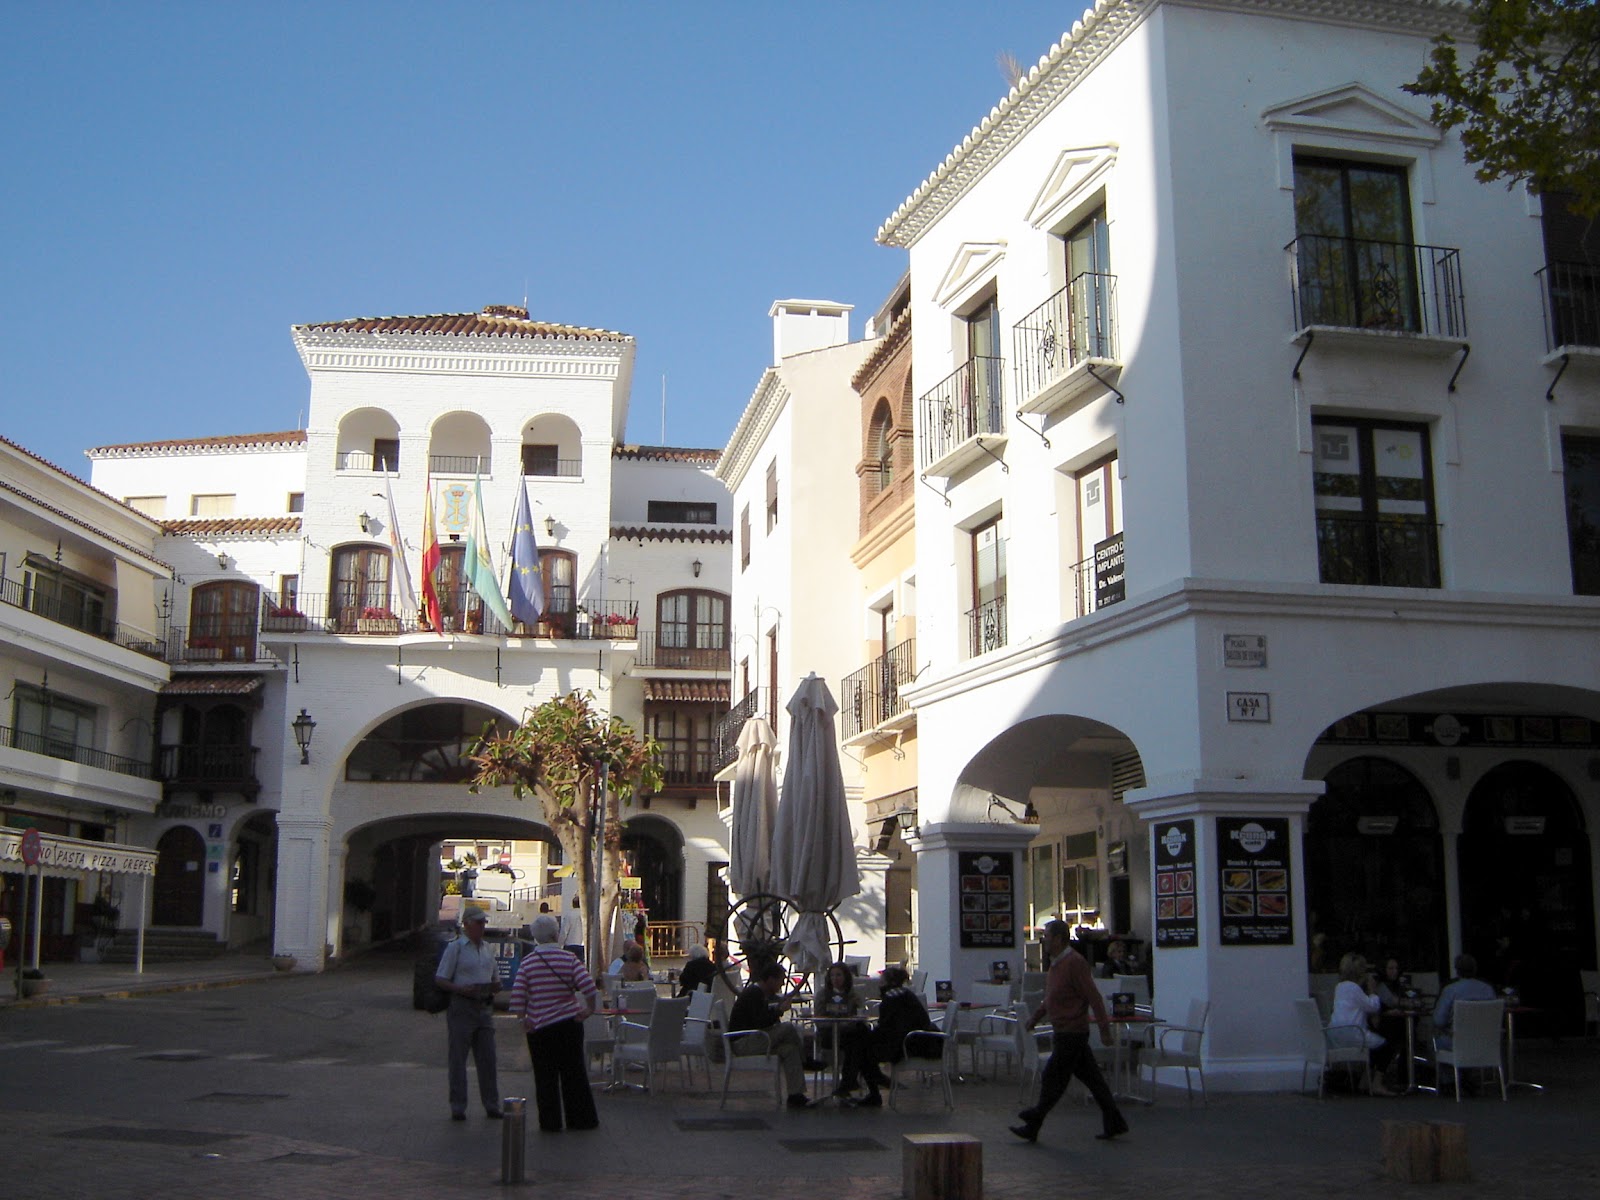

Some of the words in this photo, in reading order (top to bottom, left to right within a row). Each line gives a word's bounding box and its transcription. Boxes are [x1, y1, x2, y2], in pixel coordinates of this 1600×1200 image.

[1096, 543, 1119, 561] CENTRO
[1097, 553, 1124, 573] IMPLANTE
[1236, 698, 1260, 708] CASA
[1250, 707, 1256, 717] 7
[5, 842, 51, 859] ITANO
[56, 850, 85, 865] PASTA
[92, 854, 117, 867] PIZZA
